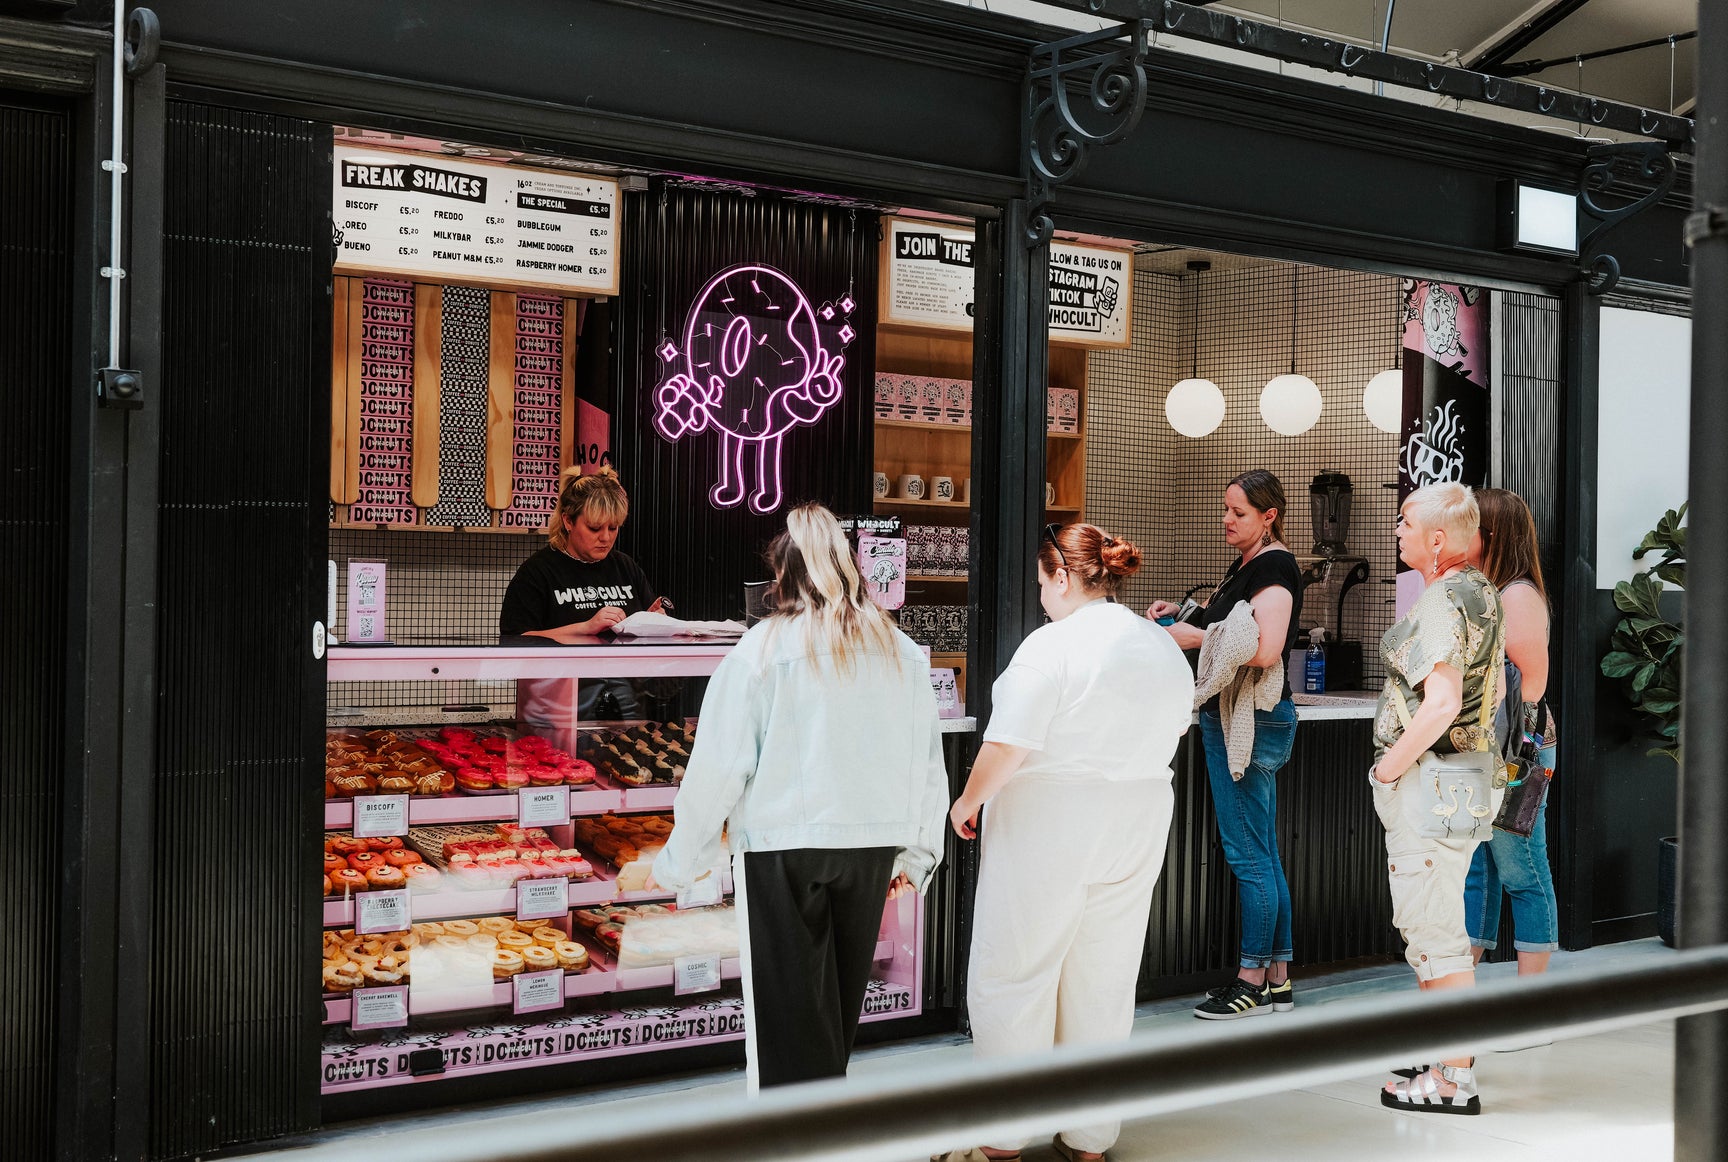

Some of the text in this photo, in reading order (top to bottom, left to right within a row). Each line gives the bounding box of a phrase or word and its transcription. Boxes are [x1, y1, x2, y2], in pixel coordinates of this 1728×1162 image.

[346, 165, 482, 198] FREAK SHAKES
[345, 200, 420, 215] BISCOFF £5.20
[522, 196, 608, 214] THE SPECIAL £5.20
[434, 210, 505, 225] FREDDO £5.20
[345, 221, 419, 235] OREO £5.20
[517, 220, 608, 237] BUBBLEGUM £5.20
[433, 230, 504, 245] MILKYBAR £5.20
[344, 241, 418, 255] BUENO £5.20
[517, 240, 607, 256] JAMMIE DODGER £5.20
[900, 236, 971, 262] JOIN THE
[433, 251, 504, 264] PEANUT M&M £5.20
[1050, 252, 1122, 271] LLOW & TAG US ON
[516, 259, 607, 275] RASPBERRY HOMER £5.20
[1049, 268, 1095, 290] STAGRAM
[354, 507, 413, 523] DONUTS
[506, 512, 551, 527] DONUT
[575, 602, 597, 610] COFFEE
[534, 794, 554, 802] HOMER
[366, 803, 395, 811] BISCOFF
[687, 962, 708, 971] COSMIC
[864, 992, 910, 1013] ONUTS
[642, 1018, 706, 1041] DONUTS
[565, 1027, 632, 1051] DONUTS
[484, 1036, 555, 1061] DONUTS
[321, 1057, 389, 1082] ONUTS
